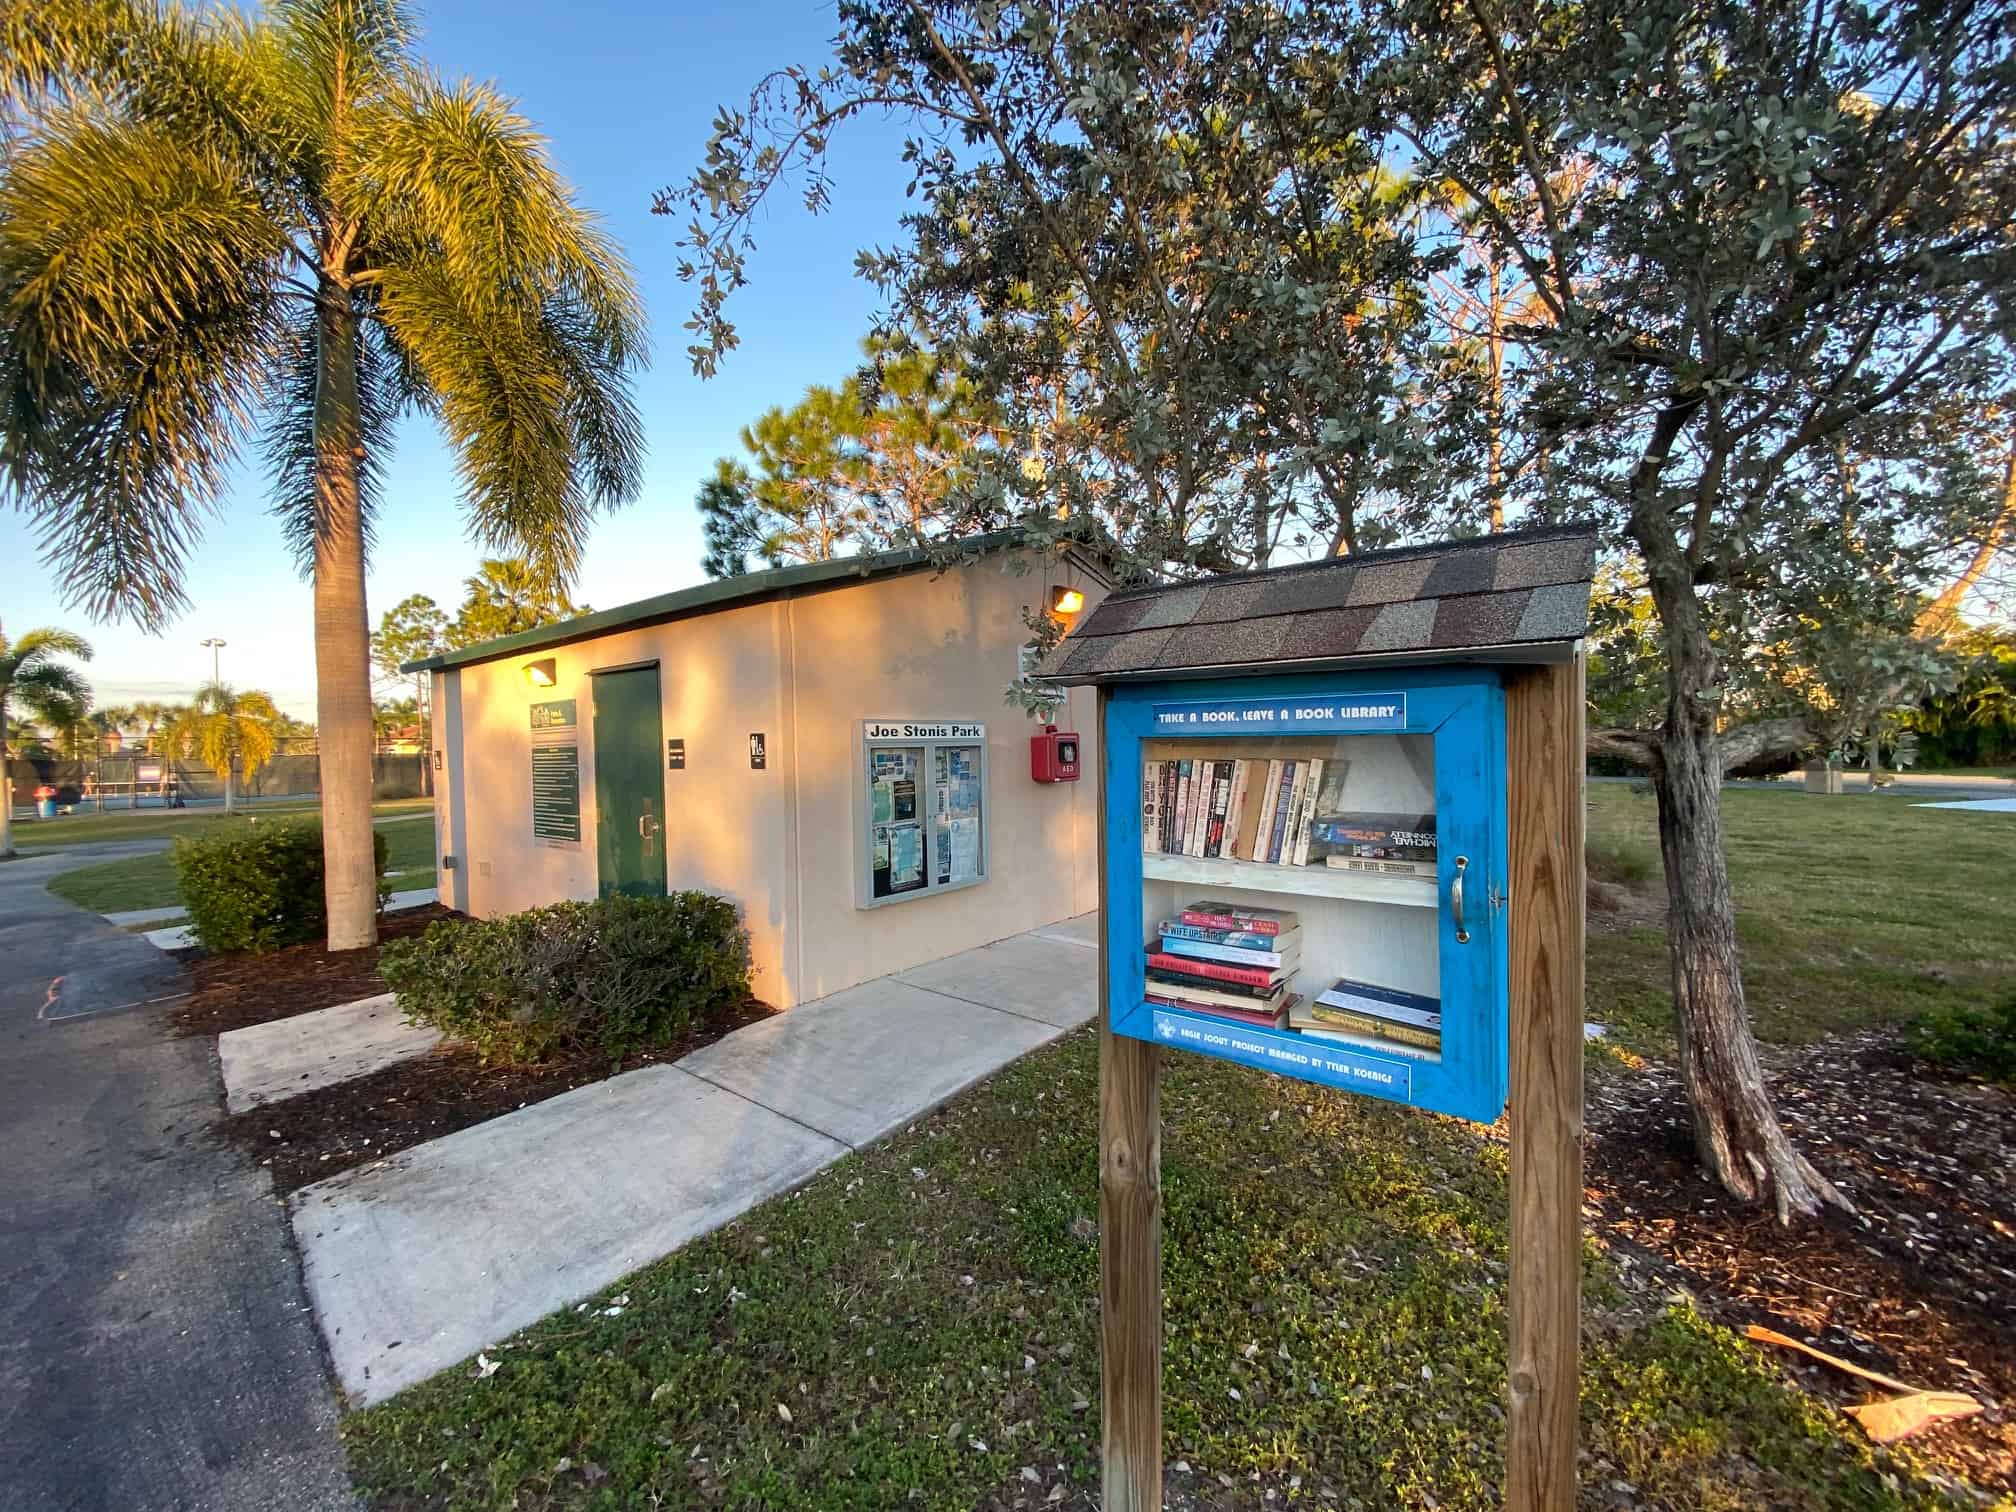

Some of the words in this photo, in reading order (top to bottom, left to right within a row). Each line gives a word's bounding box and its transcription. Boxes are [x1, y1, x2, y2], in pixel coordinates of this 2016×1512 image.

[1158, 713, 1184, 724] TAKE
[1189, 712, 1197, 723] A
[1243, 709, 1274, 721] LEAVE
[1280, 709, 1289, 720] A
[1295, 707, 1334, 720] BOOK
[1341, 705, 1397, 719] LIBRARY
[870, 725, 899, 737] Joe
[903, 724, 947, 737] Stonis
[951, 724, 981, 737] Park
[1062, 765, 1074, 773] AED
[1392, 837, 1437, 848] MICHAEL
[1169, 926, 1188, 938] WIFE
[1180, 1028, 1201, 1040] EAGLE
[1204, 1033, 1229, 1046] SCOUT
[1231, 1039, 1265, 1055] PROJECT
[1268, 1047, 1308, 1065] MANAGED
[1311, 1057, 1323, 1068] BY
[1326, 1061, 1350, 1074] TYLER
